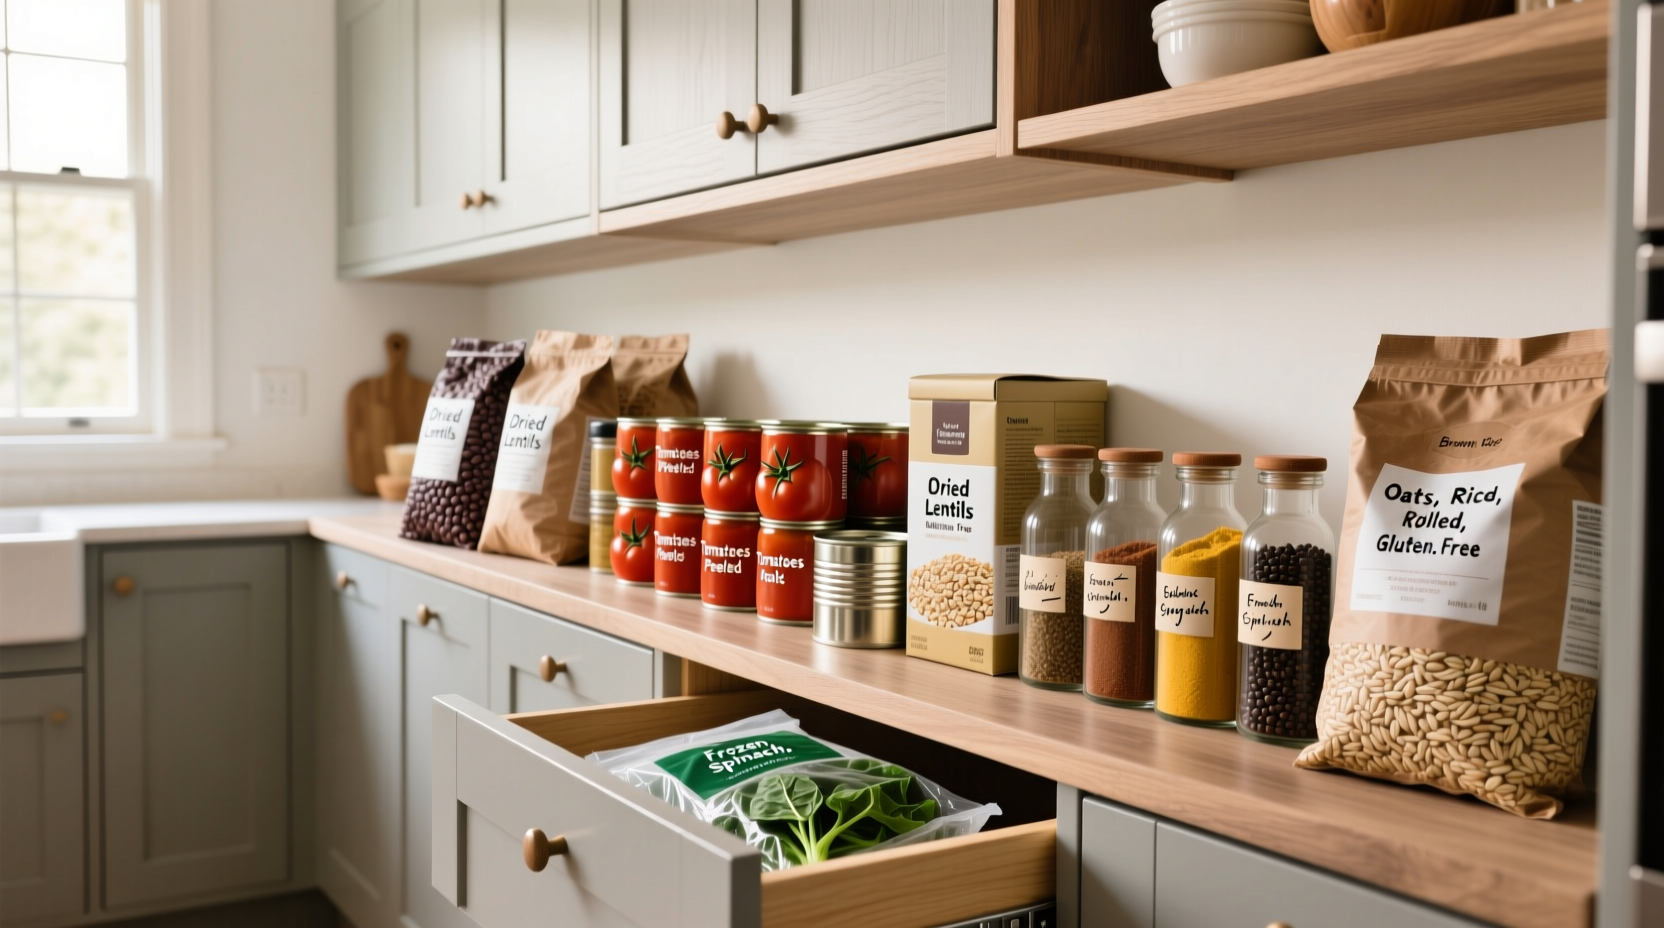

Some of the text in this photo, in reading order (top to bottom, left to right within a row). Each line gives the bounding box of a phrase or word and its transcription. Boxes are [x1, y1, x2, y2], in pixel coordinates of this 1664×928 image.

[509, 414, 547, 431] Dried
[1384, 483, 1440, 508] Oats,
[925, 498, 974, 520] Lentils
[1402, 510, 1466, 533] Rolled,
[704, 558, 742, 574] Peeled
[703, 740, 769, 762] Frozen
[708, 743, 793, 774] Spinach.
